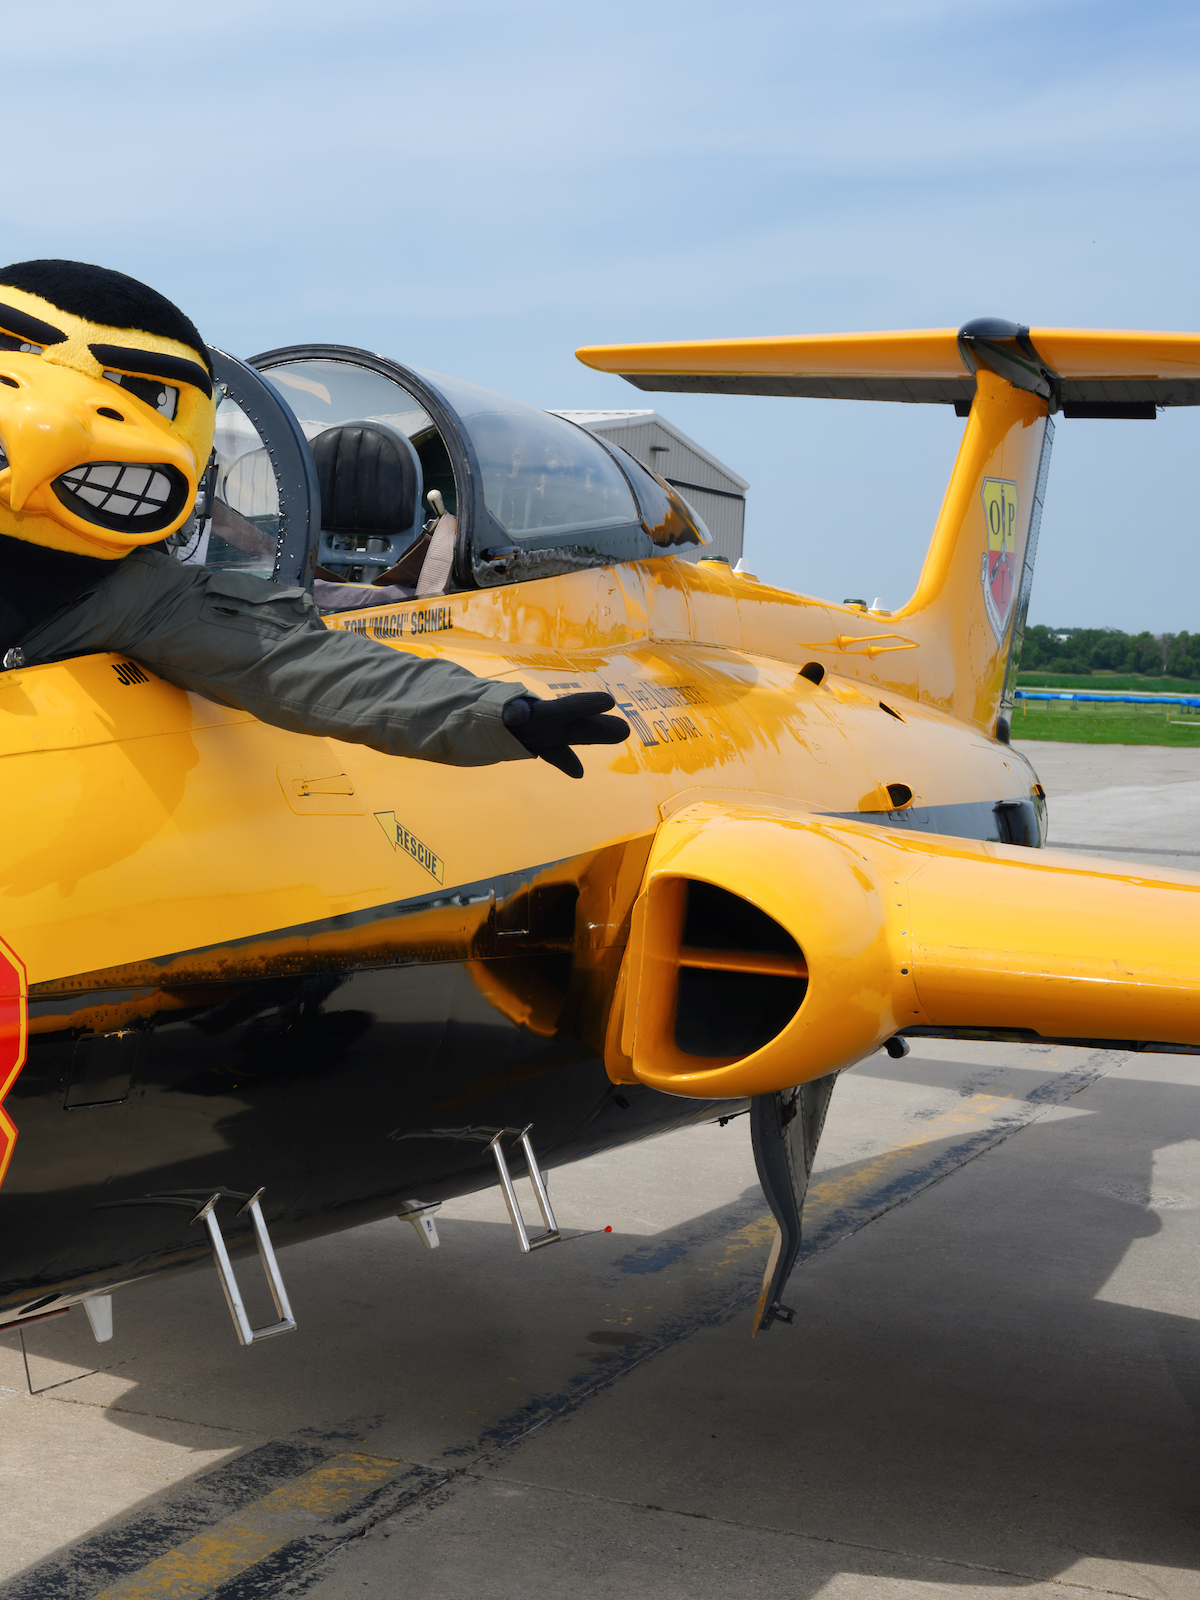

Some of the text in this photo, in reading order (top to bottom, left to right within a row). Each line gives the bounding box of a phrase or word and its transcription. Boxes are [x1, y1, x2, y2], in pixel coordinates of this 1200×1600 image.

[344, 606, 453, 640] TOM "MACH" SCHNELL
[110, 661, 150, 686] JIM
[396, 823, 437, 876] RESCUE
